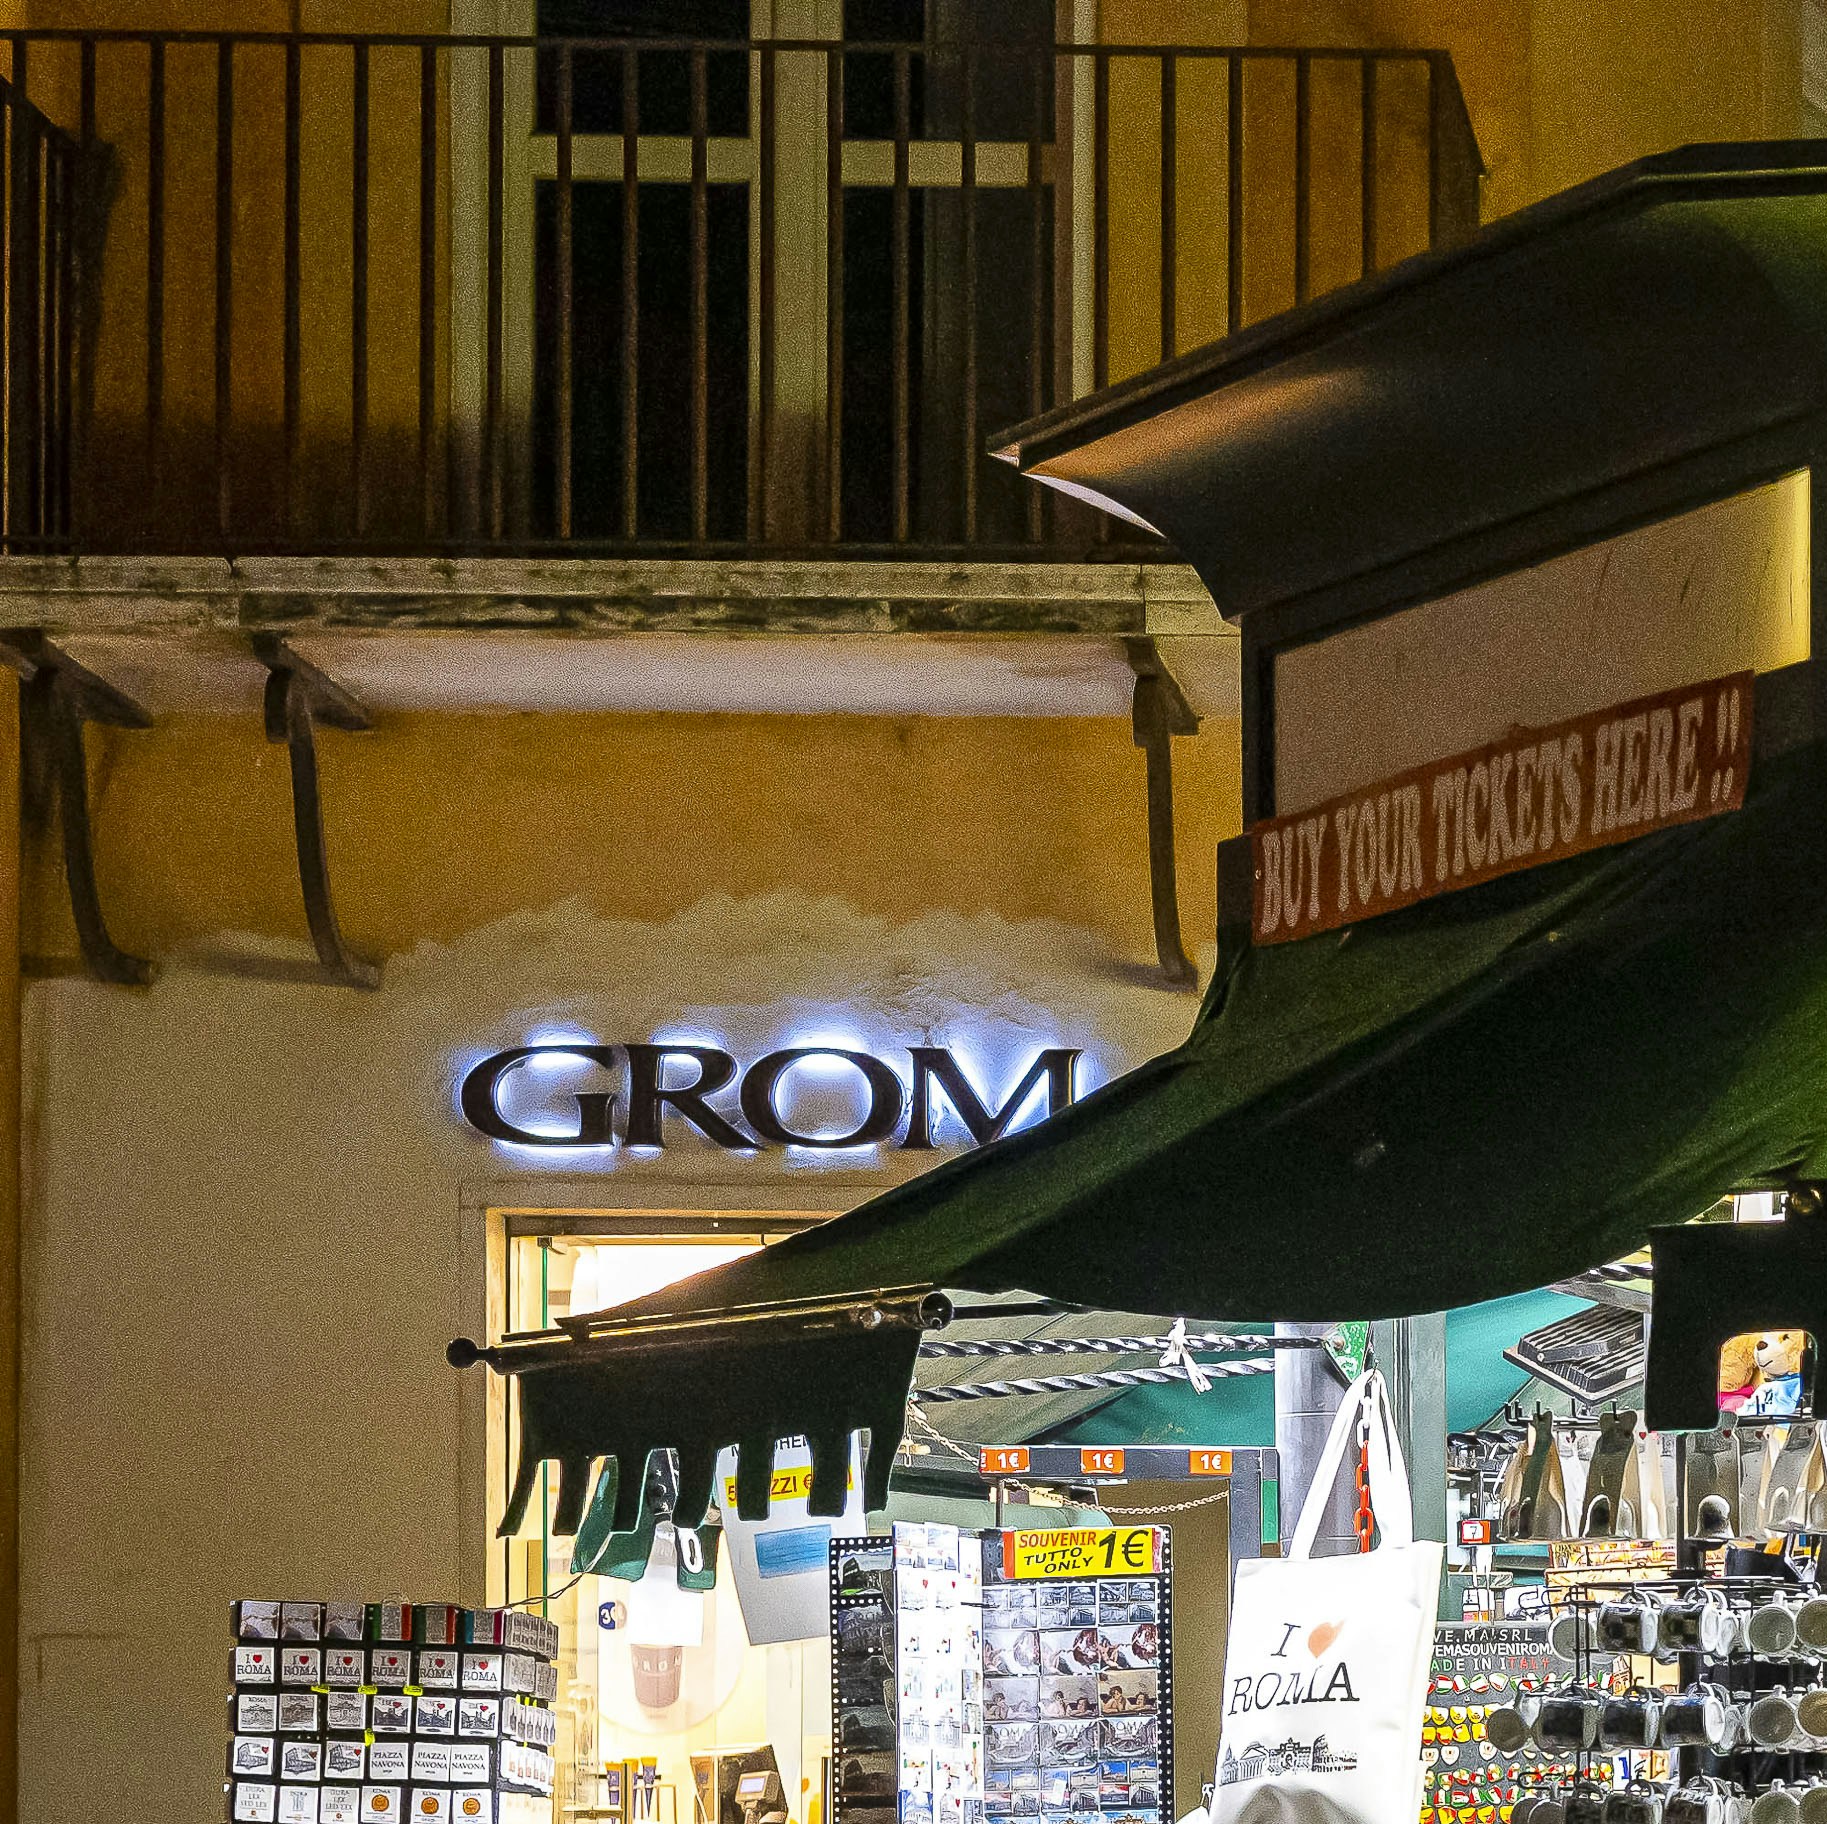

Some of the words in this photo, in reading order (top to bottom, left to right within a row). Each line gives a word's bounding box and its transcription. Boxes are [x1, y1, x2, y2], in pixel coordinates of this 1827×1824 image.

[1261, 815, 1328, 935] BUY
[1335, 785, 1423, 913] YOUR
[1433, 733, 1583, 882] TICKETS
[1591, 698, 1704, 835] HERE
[461, 1042, 1084, 1151] GROM
[996, 1451, 1021, 1469] 1€
[1093, 1452, 1115, 1469] 1€
[1201, 1452, 1222, 1469] 1€
[1019, 1532, 1096, 1548] SOUVENIR
[1099, 1530, 1149, 1568] 1€
[1024, 1547, 1082, 1565] TUTTO
[1044, 1556, 1093, 1573] ONLY
[1271, 1623, 1300, 1657] I
[419, 1668, 454, 1679] ROMA
[1431, 1660, 1465, 1671] ADE
[1474, 1658, 1492, 1670] IN
[463, 1671, 497, 1682] ROMA
[1228, 1662, 1360, 1716] ROMA
